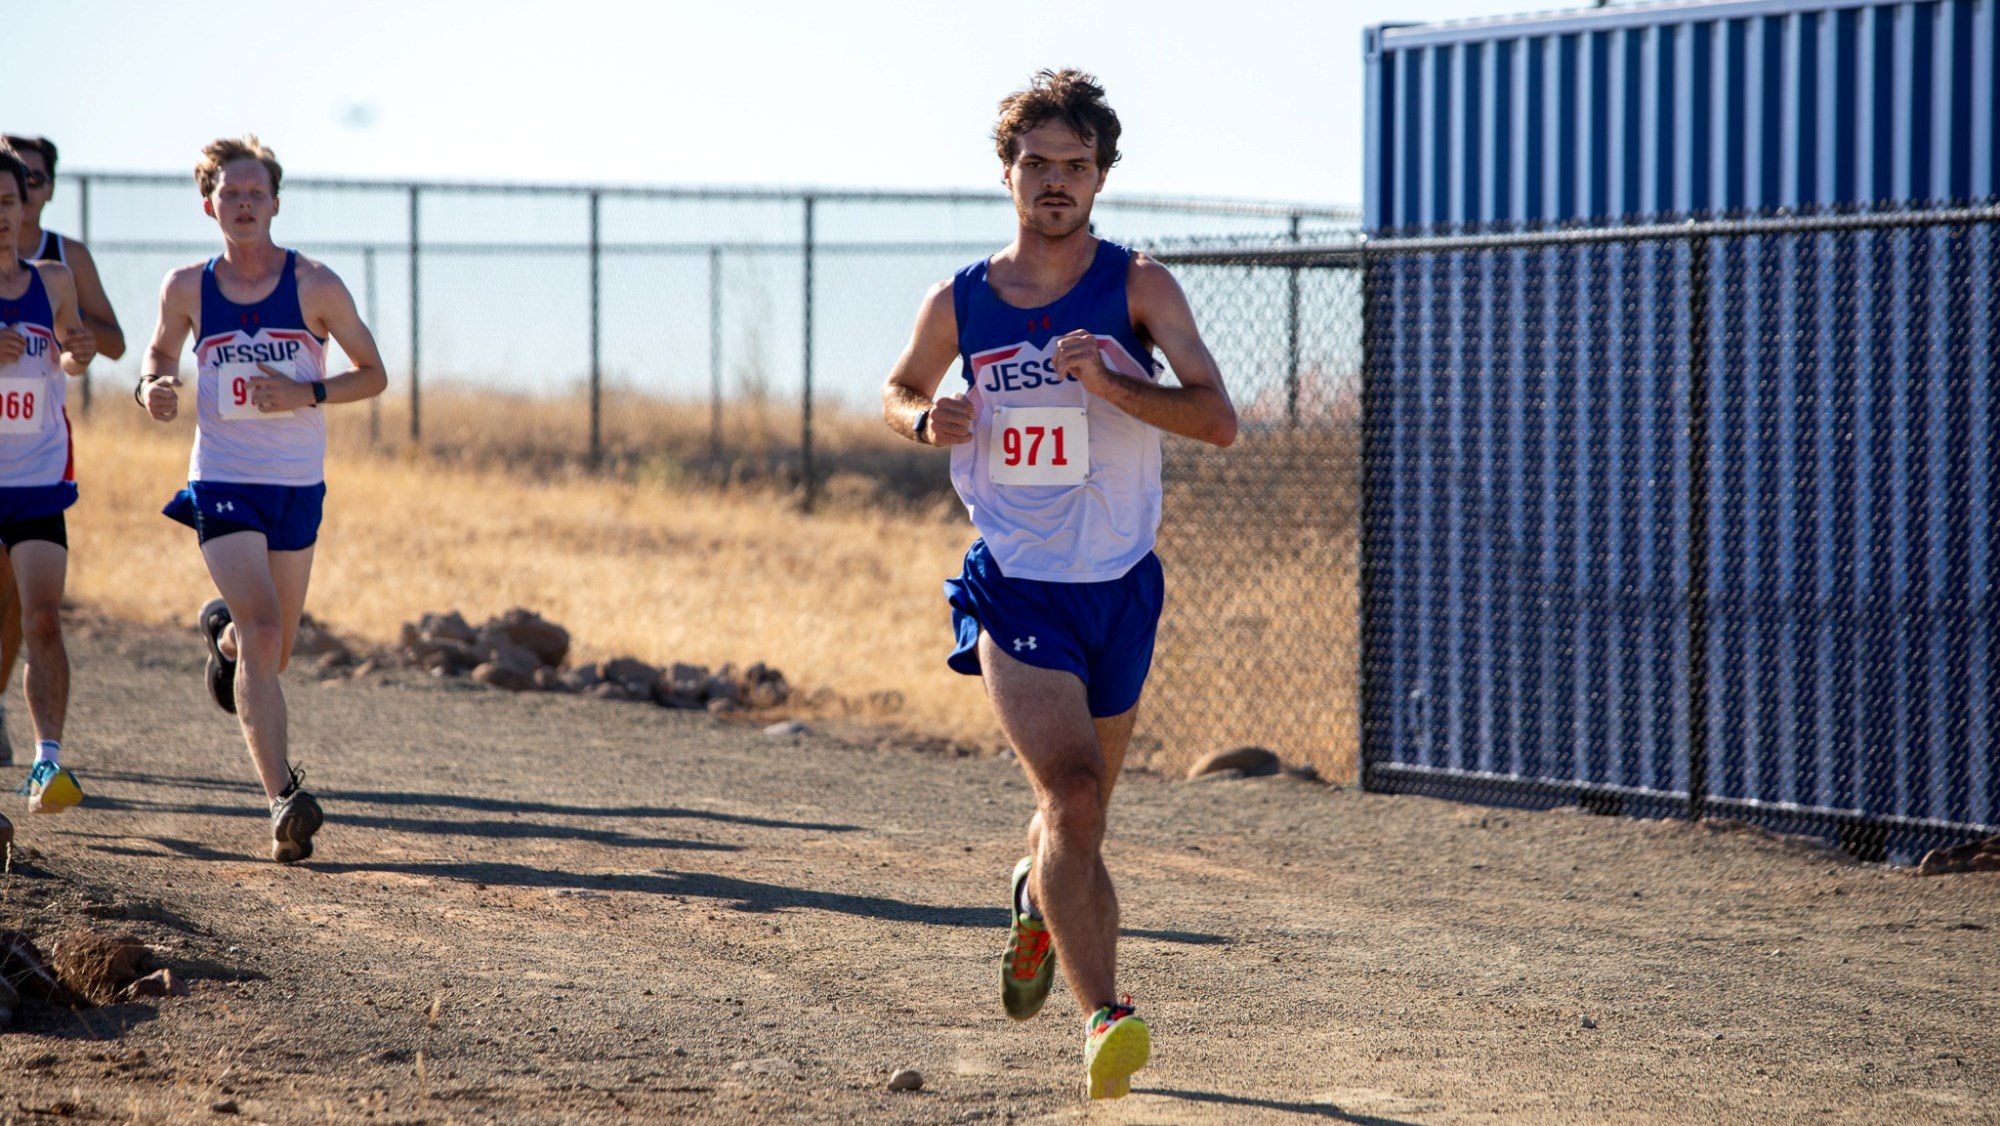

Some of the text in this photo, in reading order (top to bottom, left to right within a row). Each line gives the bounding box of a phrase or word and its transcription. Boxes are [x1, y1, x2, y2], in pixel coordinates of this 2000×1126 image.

[212, 341, 300, 367] JESSUP
[985, 357, 1079, 392] JESS
[0, 391, 34, 419] 68
[1003, 426, 1067, 467] 971
